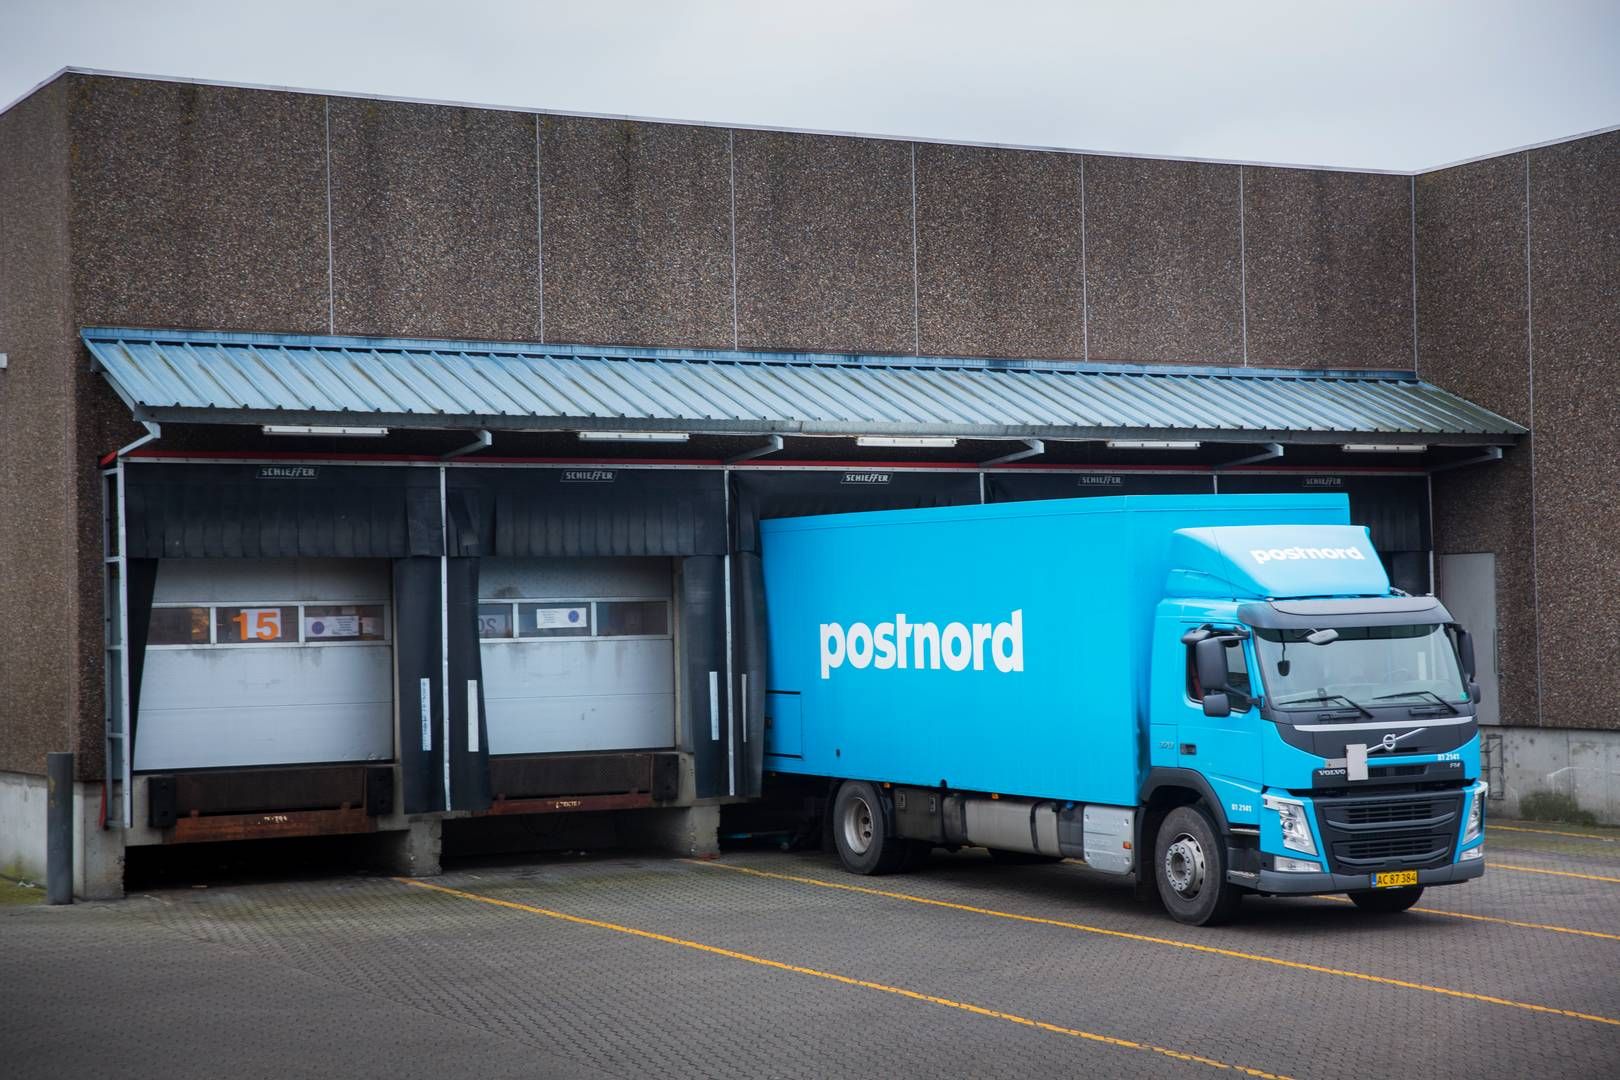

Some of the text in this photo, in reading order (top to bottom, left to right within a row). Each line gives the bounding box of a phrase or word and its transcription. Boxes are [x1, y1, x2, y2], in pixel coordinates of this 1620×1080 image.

[261, 467, 315, 476] SCHIEFFER
[565, 471, 613, 480] SCHIEFFER
[846, 473, 889, 482] SCHIEFFER
[1248, 546, 1365, 564] postnord
[232, 611, 279, 641] 15
[819, 608, 1024, 680] postnord
[1318, 768, 1346, 776] VOLVO
[1377, 872, 1416, 885] AC 87 384
